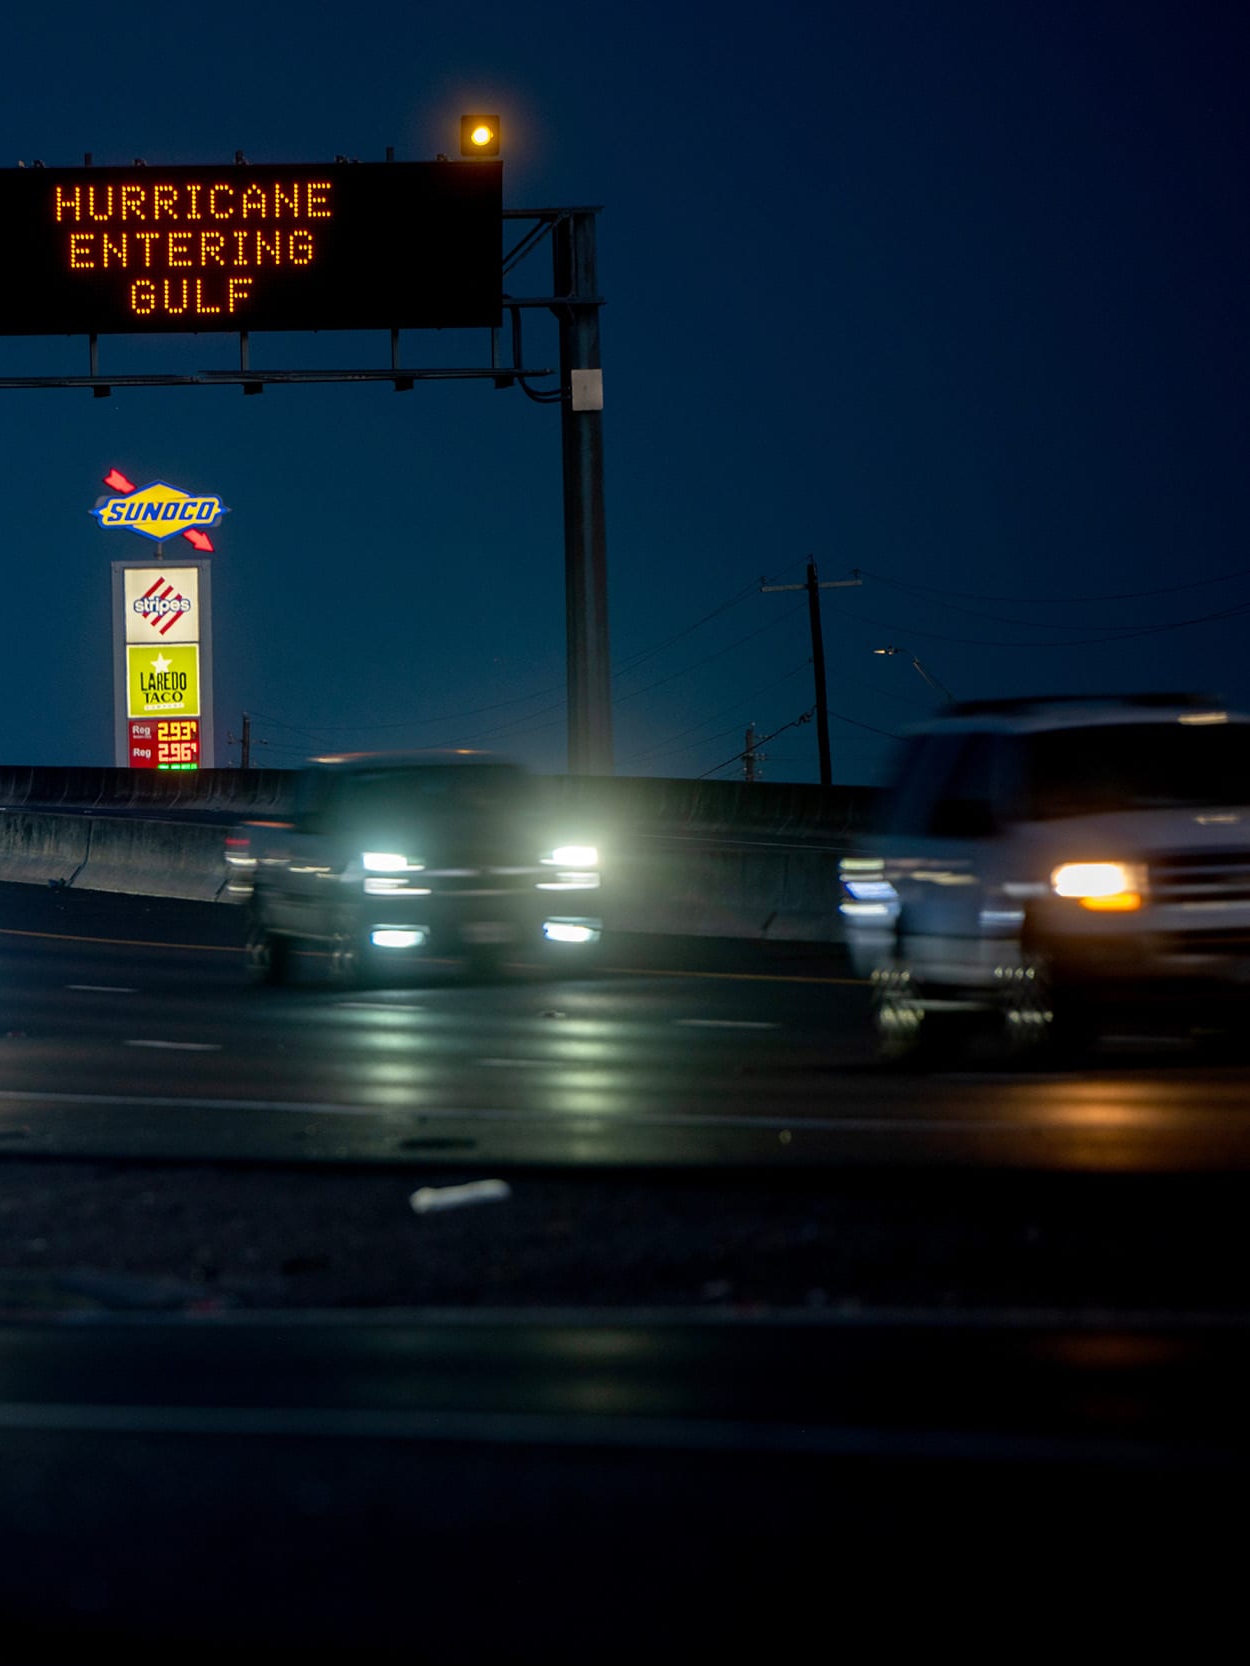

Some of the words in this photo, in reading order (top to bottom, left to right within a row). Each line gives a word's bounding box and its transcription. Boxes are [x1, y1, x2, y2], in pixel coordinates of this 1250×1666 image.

[56, 183, 332, 221] HURRICANE
[70, 230, 313, 268] ENTERING
[131, 279, 253, 314] GULF
[107, 501, 216, 522] SUNOCO
[134, 596, 191, 616] stripes
[140, 671, 187, 692] LAREDO
[143, 691, 184, 704] TACO
[132, 725, 151, 735] Reg
[133, 748, 151, 759] Reg
